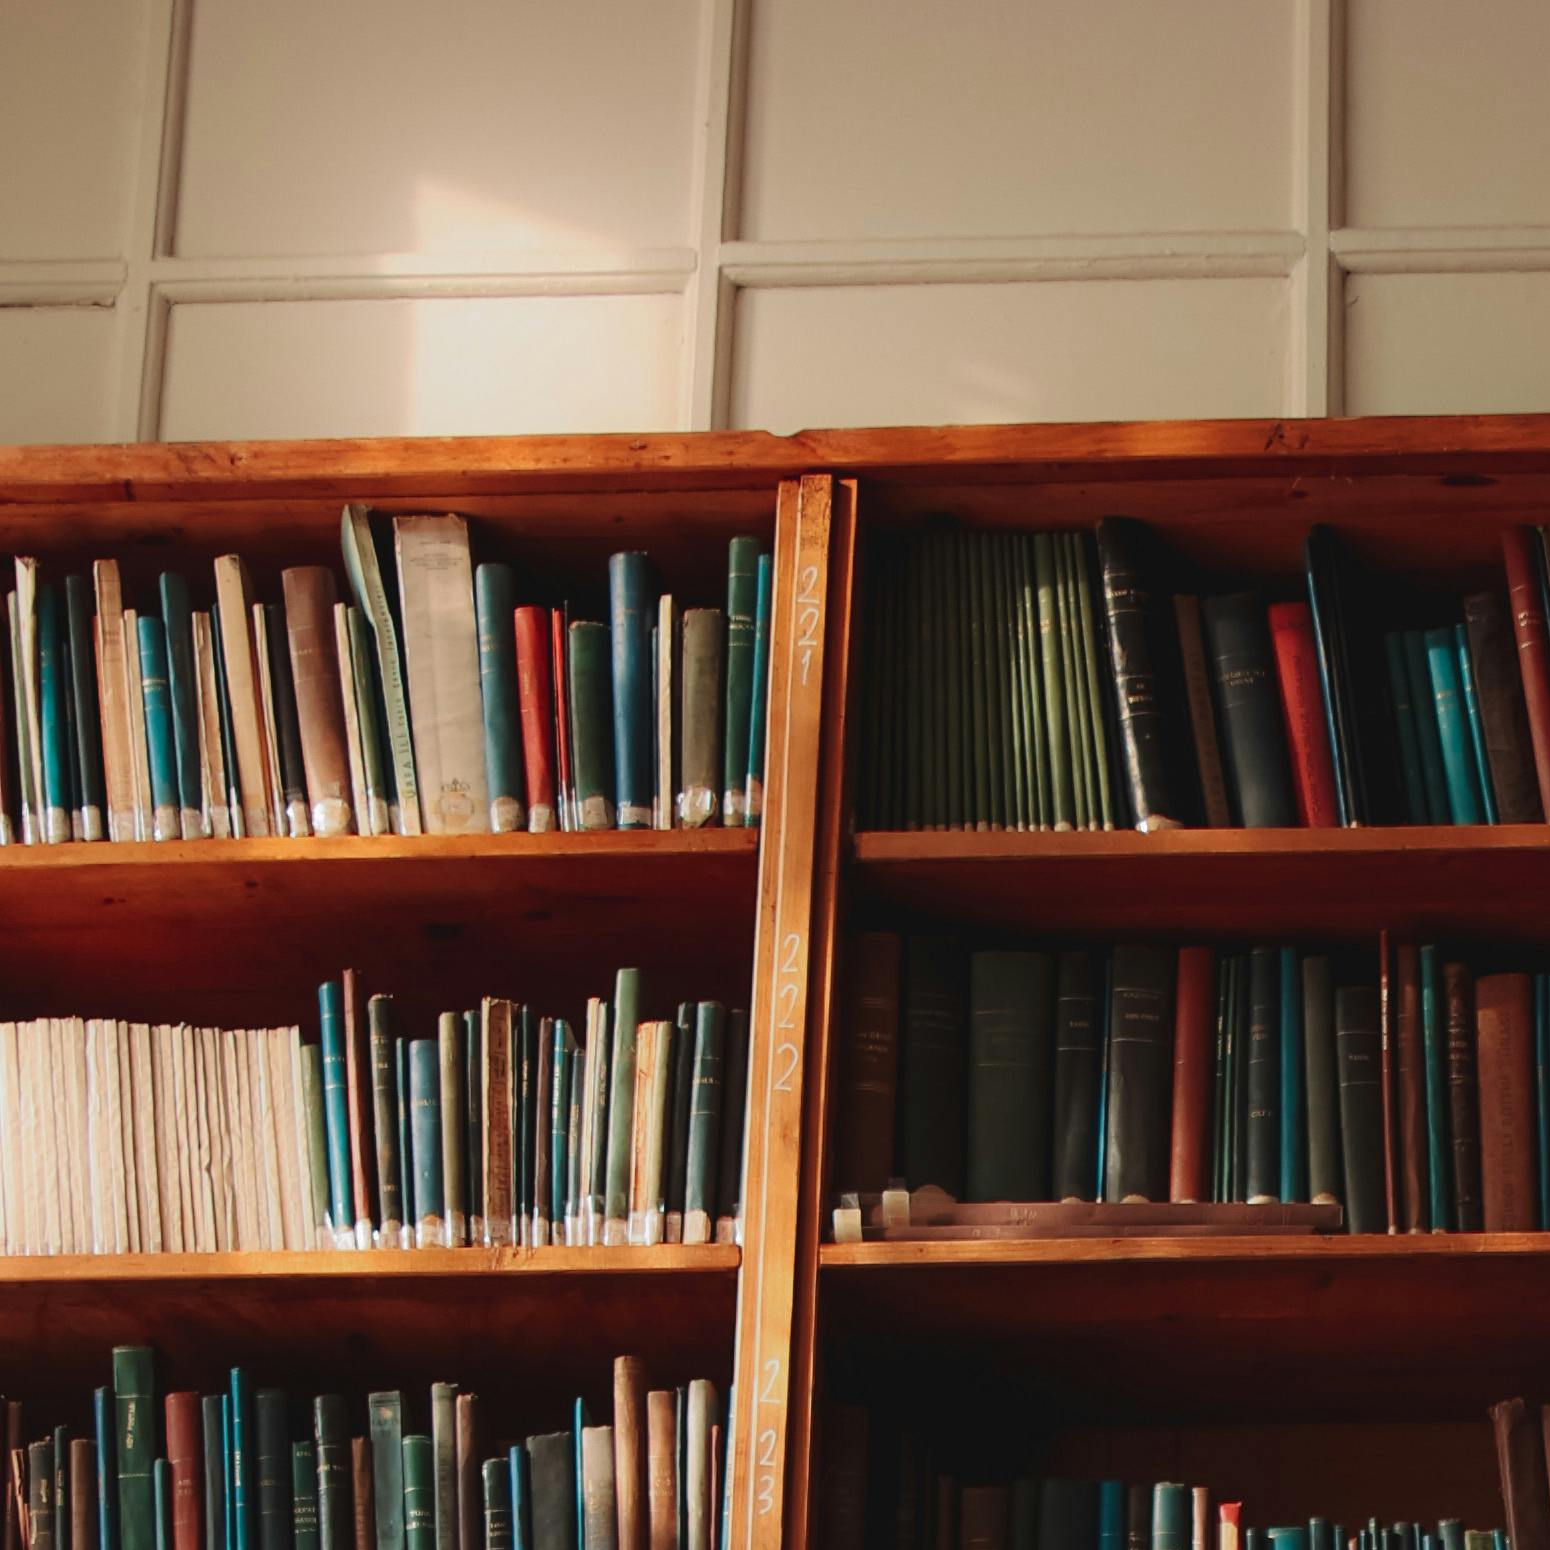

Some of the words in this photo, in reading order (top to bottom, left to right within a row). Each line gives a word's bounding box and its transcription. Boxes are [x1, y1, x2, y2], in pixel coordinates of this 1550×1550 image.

[797, 565, 820, 685] 221
[774, 933, 801, 1091] 222
[758, 1359, 781, 1514] 223
